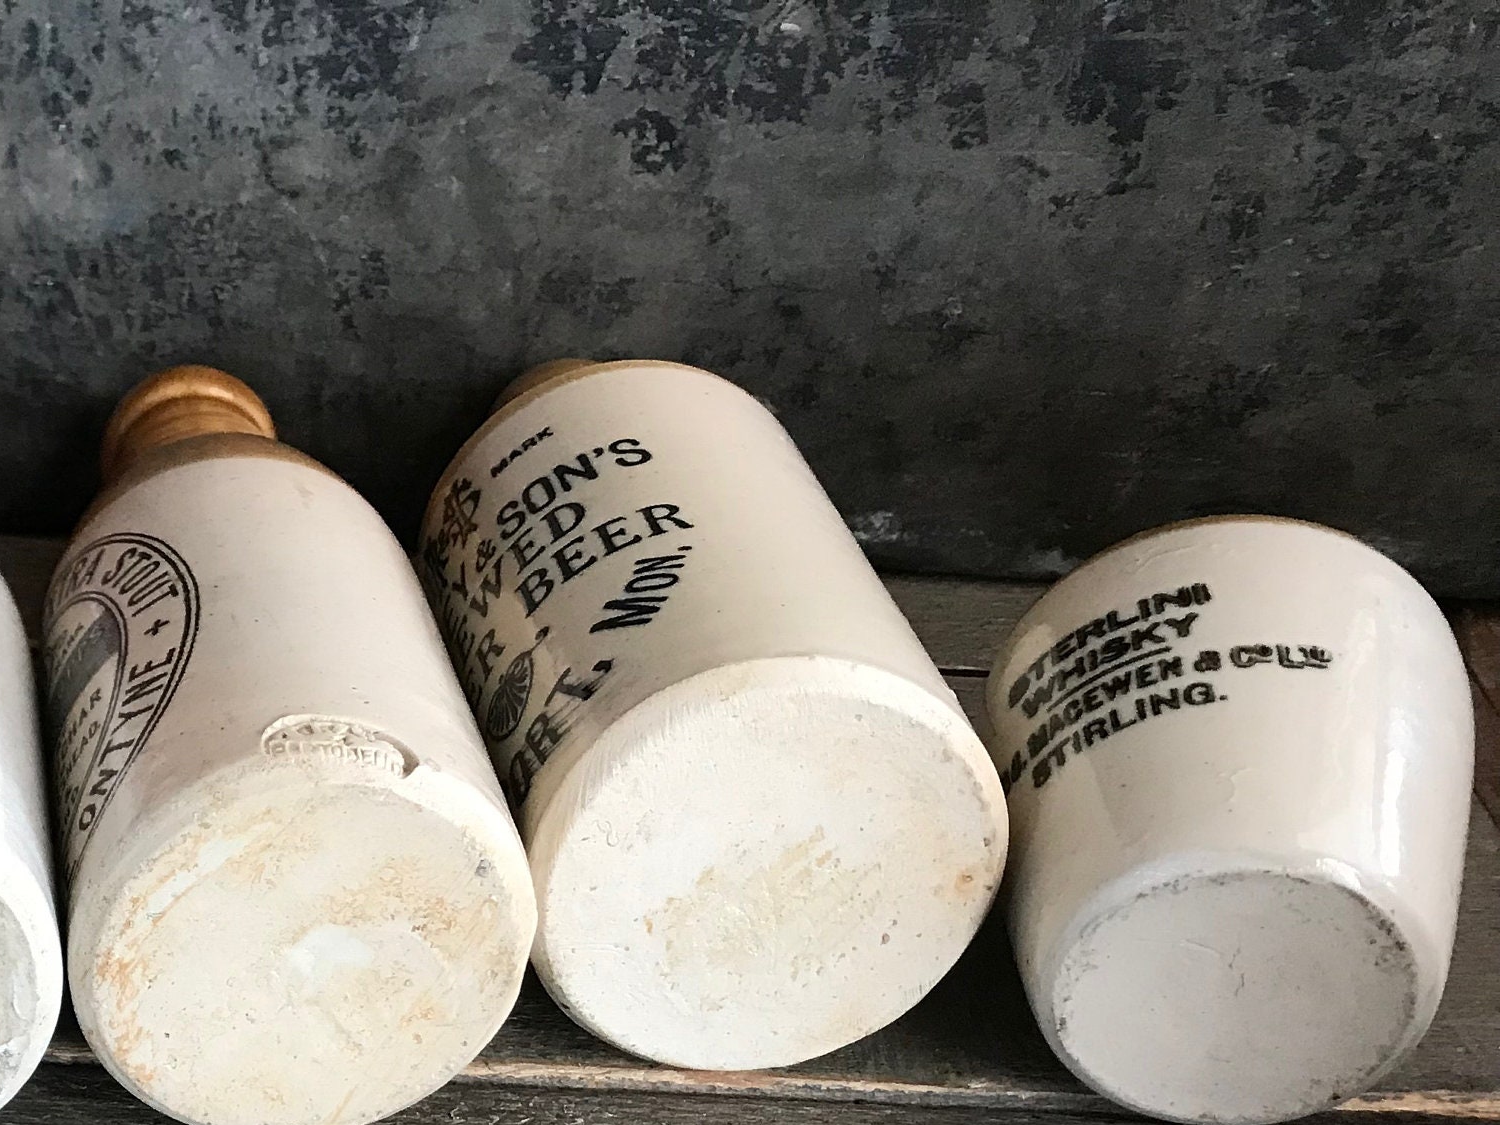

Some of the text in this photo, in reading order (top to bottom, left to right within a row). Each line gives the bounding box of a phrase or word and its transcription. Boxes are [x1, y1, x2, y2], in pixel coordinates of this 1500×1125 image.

[496, 437, 653, 541] SON'S
[101, 547, 180, 618] STOUT
[514, 503, 695, 618] BEER
[1021, 611, 1199, 719] WHISKY
